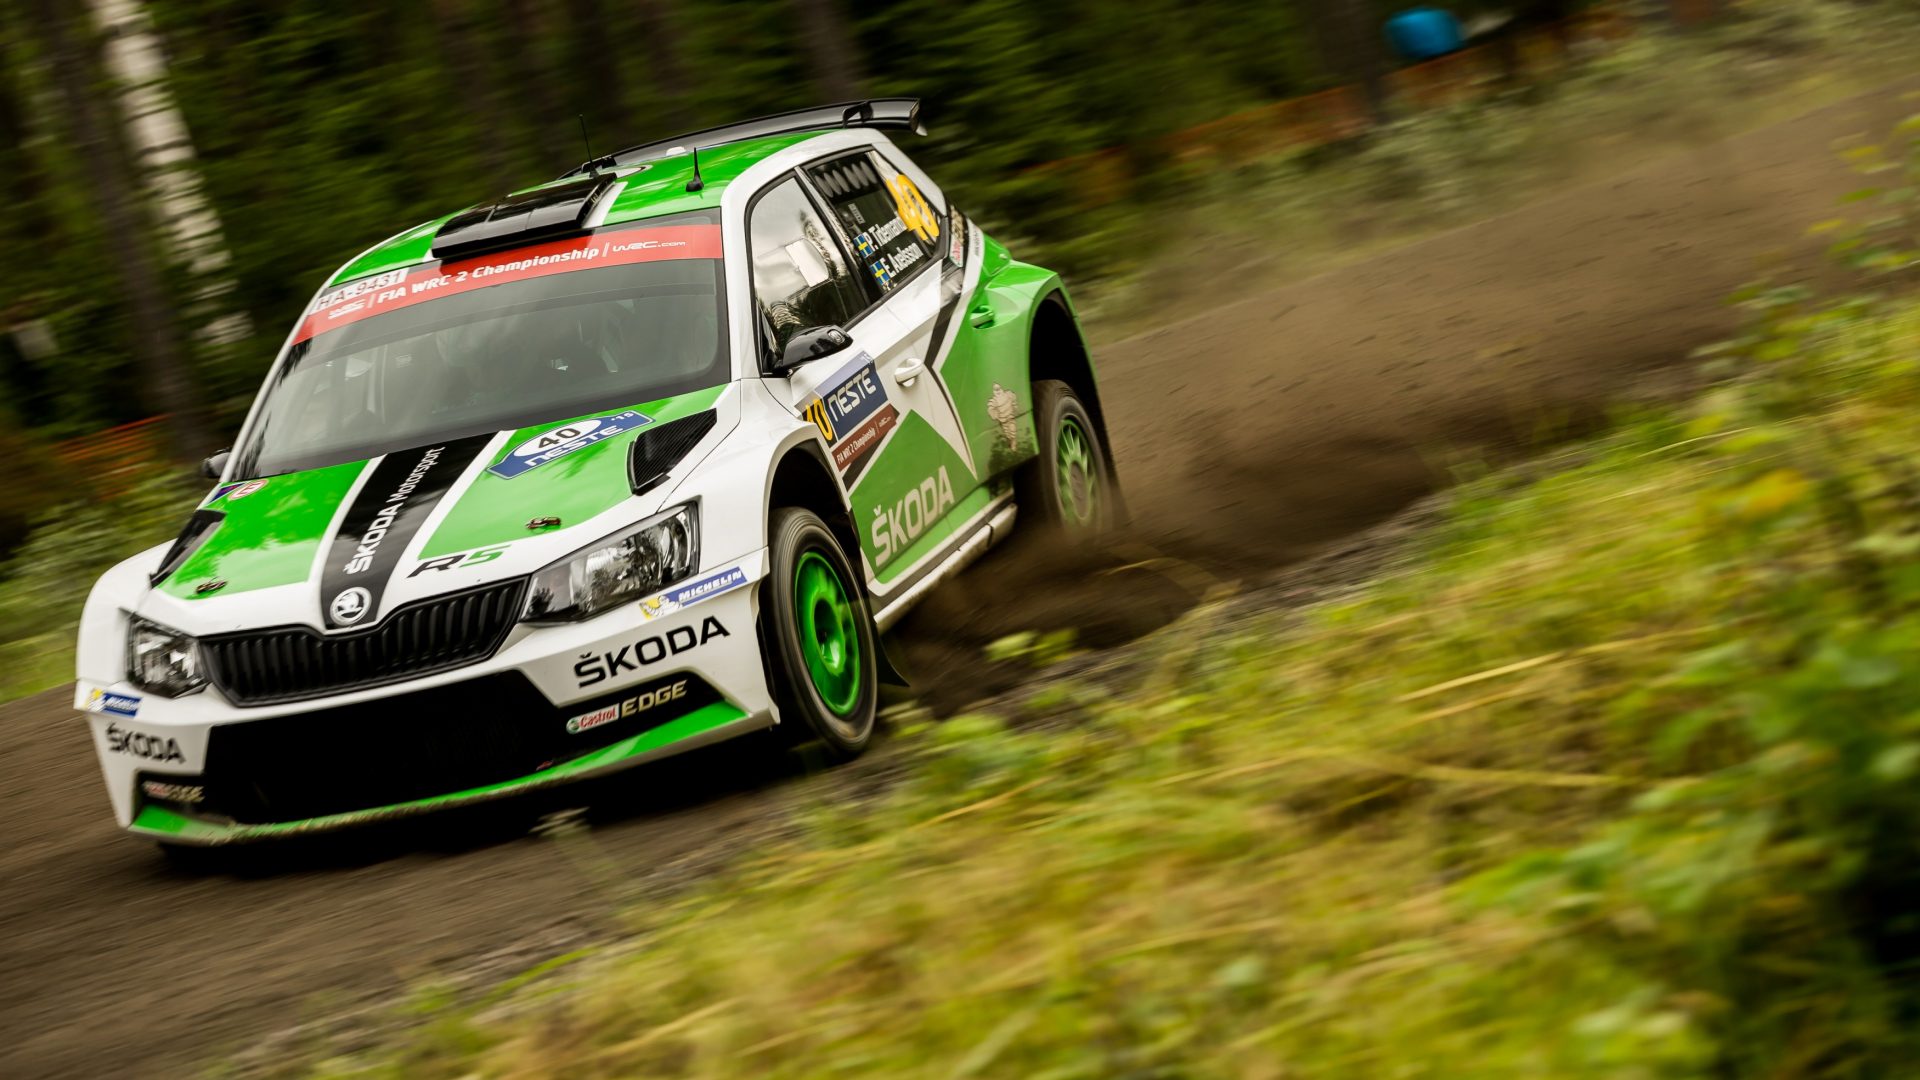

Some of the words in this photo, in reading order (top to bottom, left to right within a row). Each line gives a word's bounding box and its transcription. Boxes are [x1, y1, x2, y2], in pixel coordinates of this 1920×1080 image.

[377, 287, 407, 304] FIA
[411, 273, 452, 294] WRC
[455, 270, 468, 283] 2
[472, 246, 600, 279] Championship
[524, 425, 624, 467] NESTE
[537, 427, 581, 449] 40
[386, 446, 447, 504] Motorsport
[872, 465, 955, 567] ŠKODA
[406, 544, 512, 578] R5
[678, 569, 742, 602] MICHELIN
[573, 615, 731, 689] ŠKODA
[578, 706, 618, 728] Castrol
[621, 679, 688, 718] EDGE
